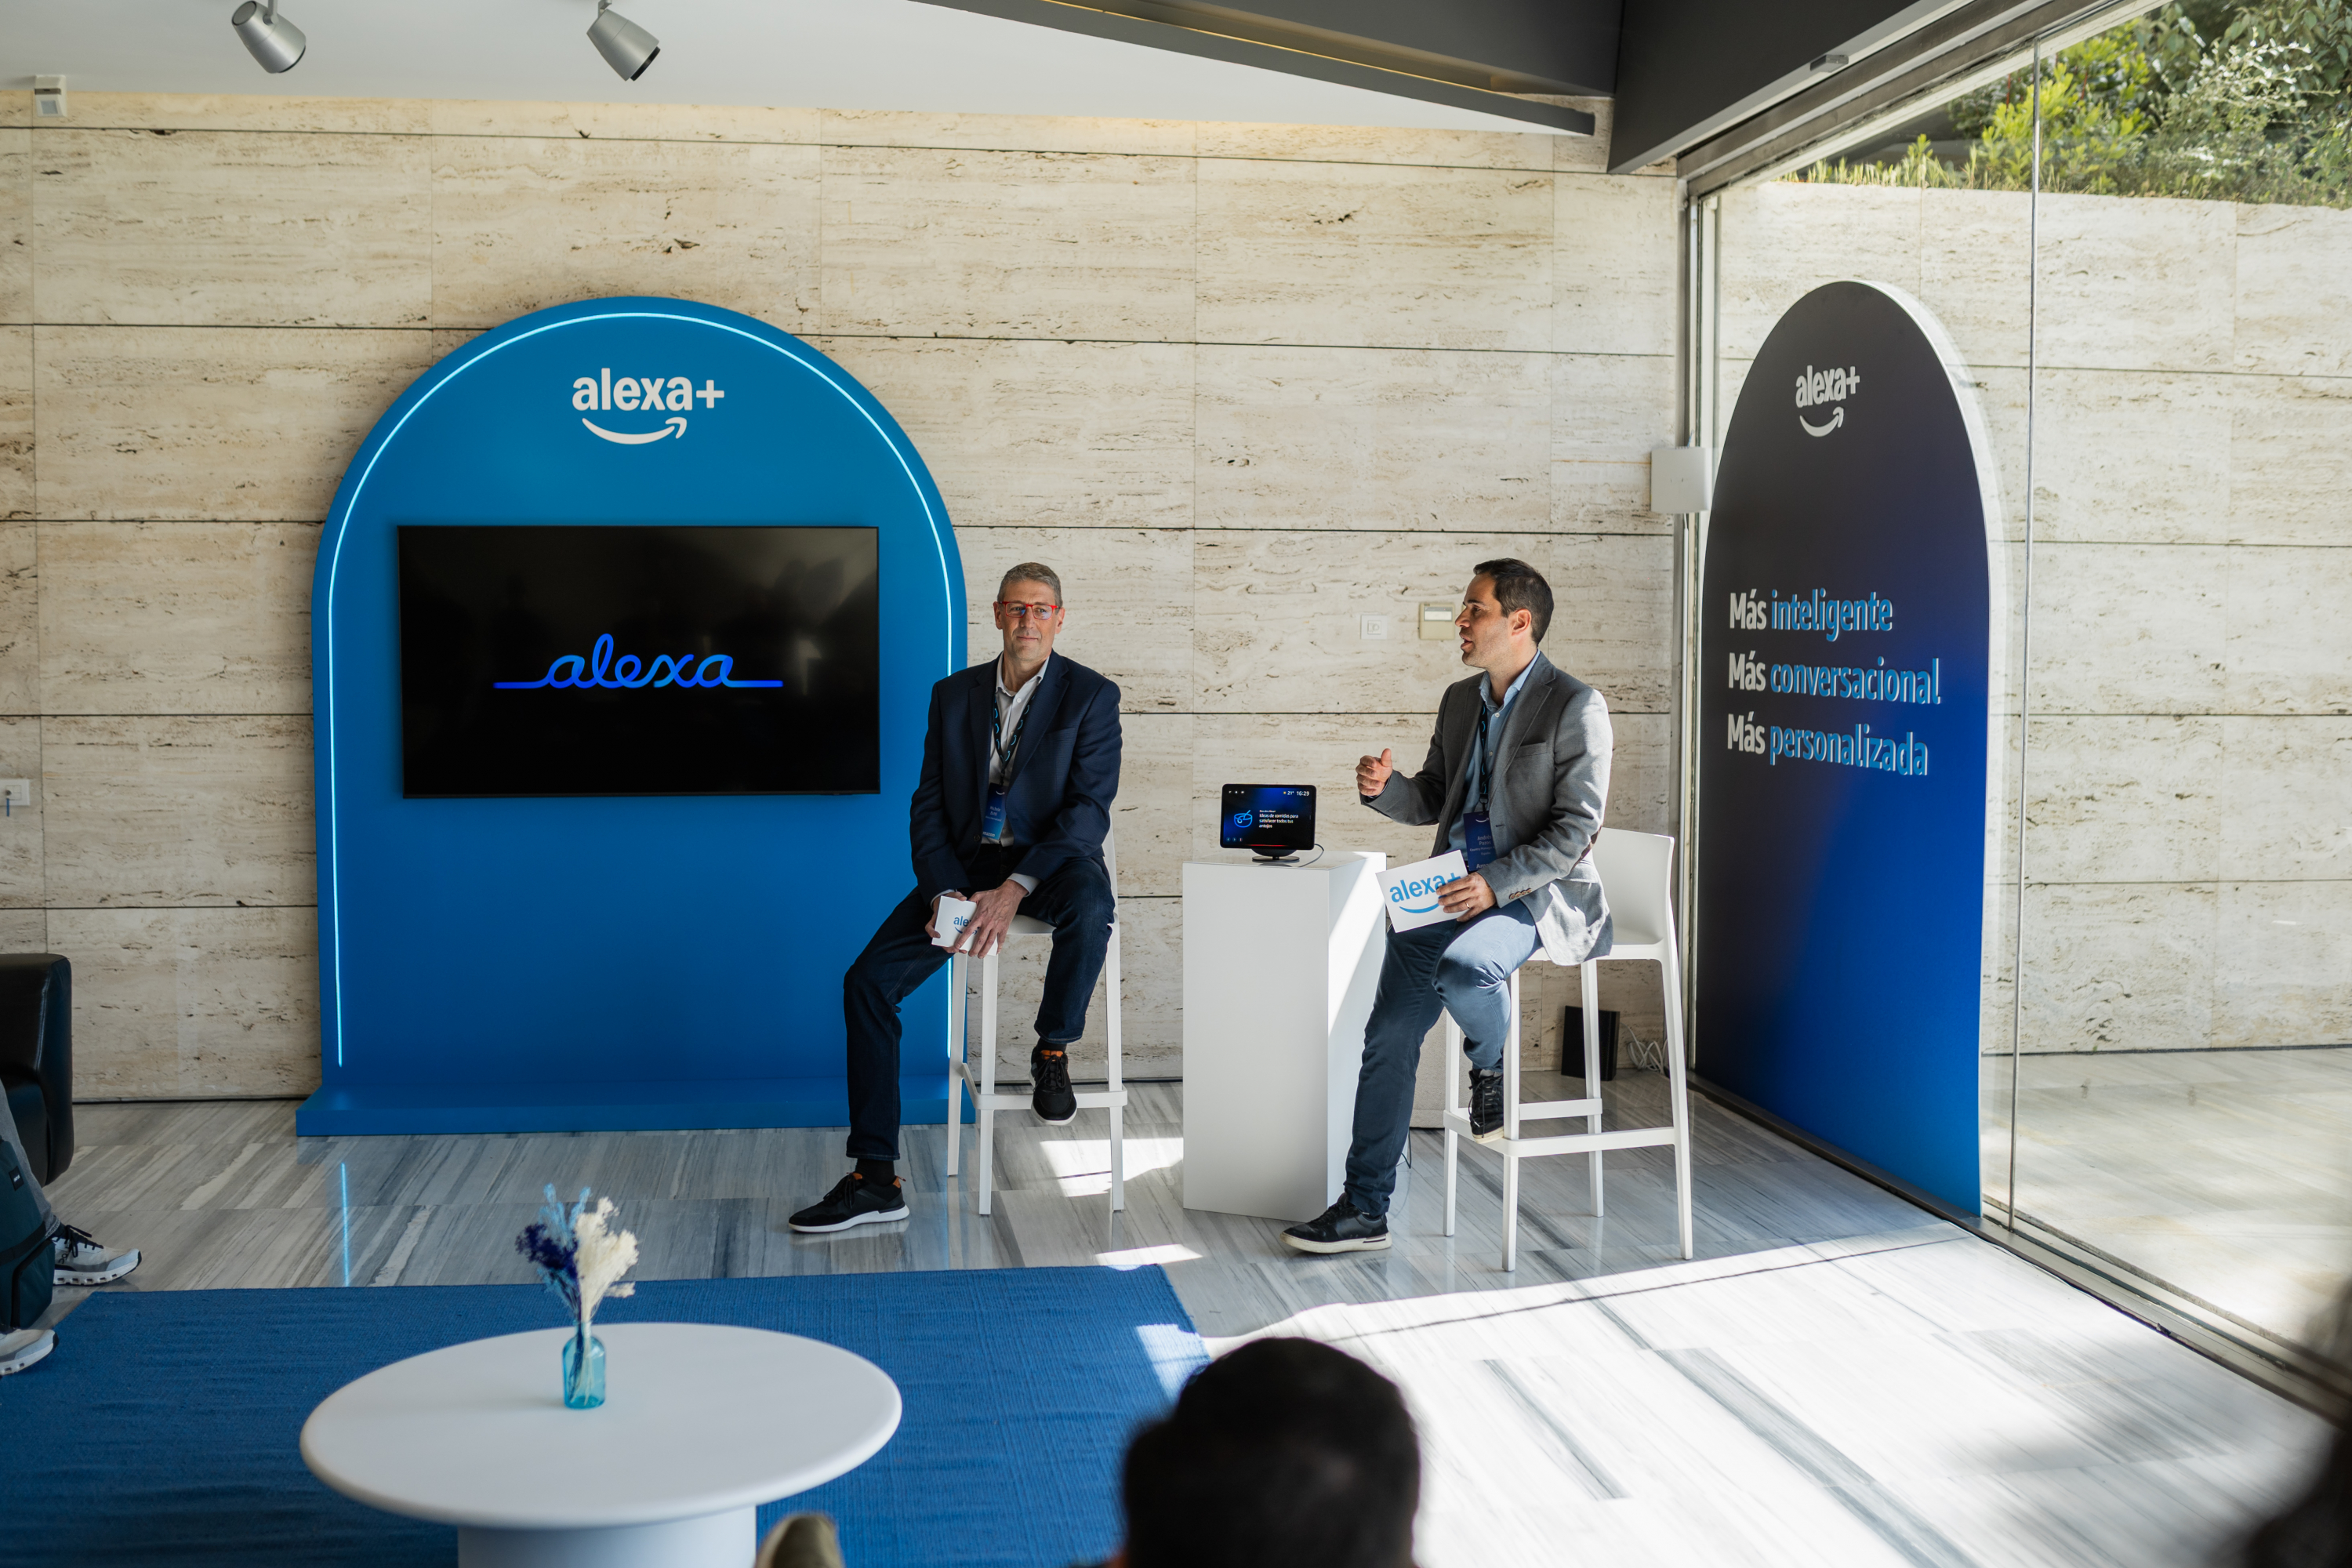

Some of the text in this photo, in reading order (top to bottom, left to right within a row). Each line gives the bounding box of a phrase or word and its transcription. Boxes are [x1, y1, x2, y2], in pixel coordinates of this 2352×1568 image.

[572, 368, 725, 411] alexa+
[1795, 365, 1860, 408] alexa+
[1730, 588, 1893, 641] Más inteligente
[493, 633, 783, 689] alexa
[1728, 650, 1940, 704] Más conversacional
[1727, 711, 1928, 775] Más personalizada
[953, 916, 972, 927] ale
